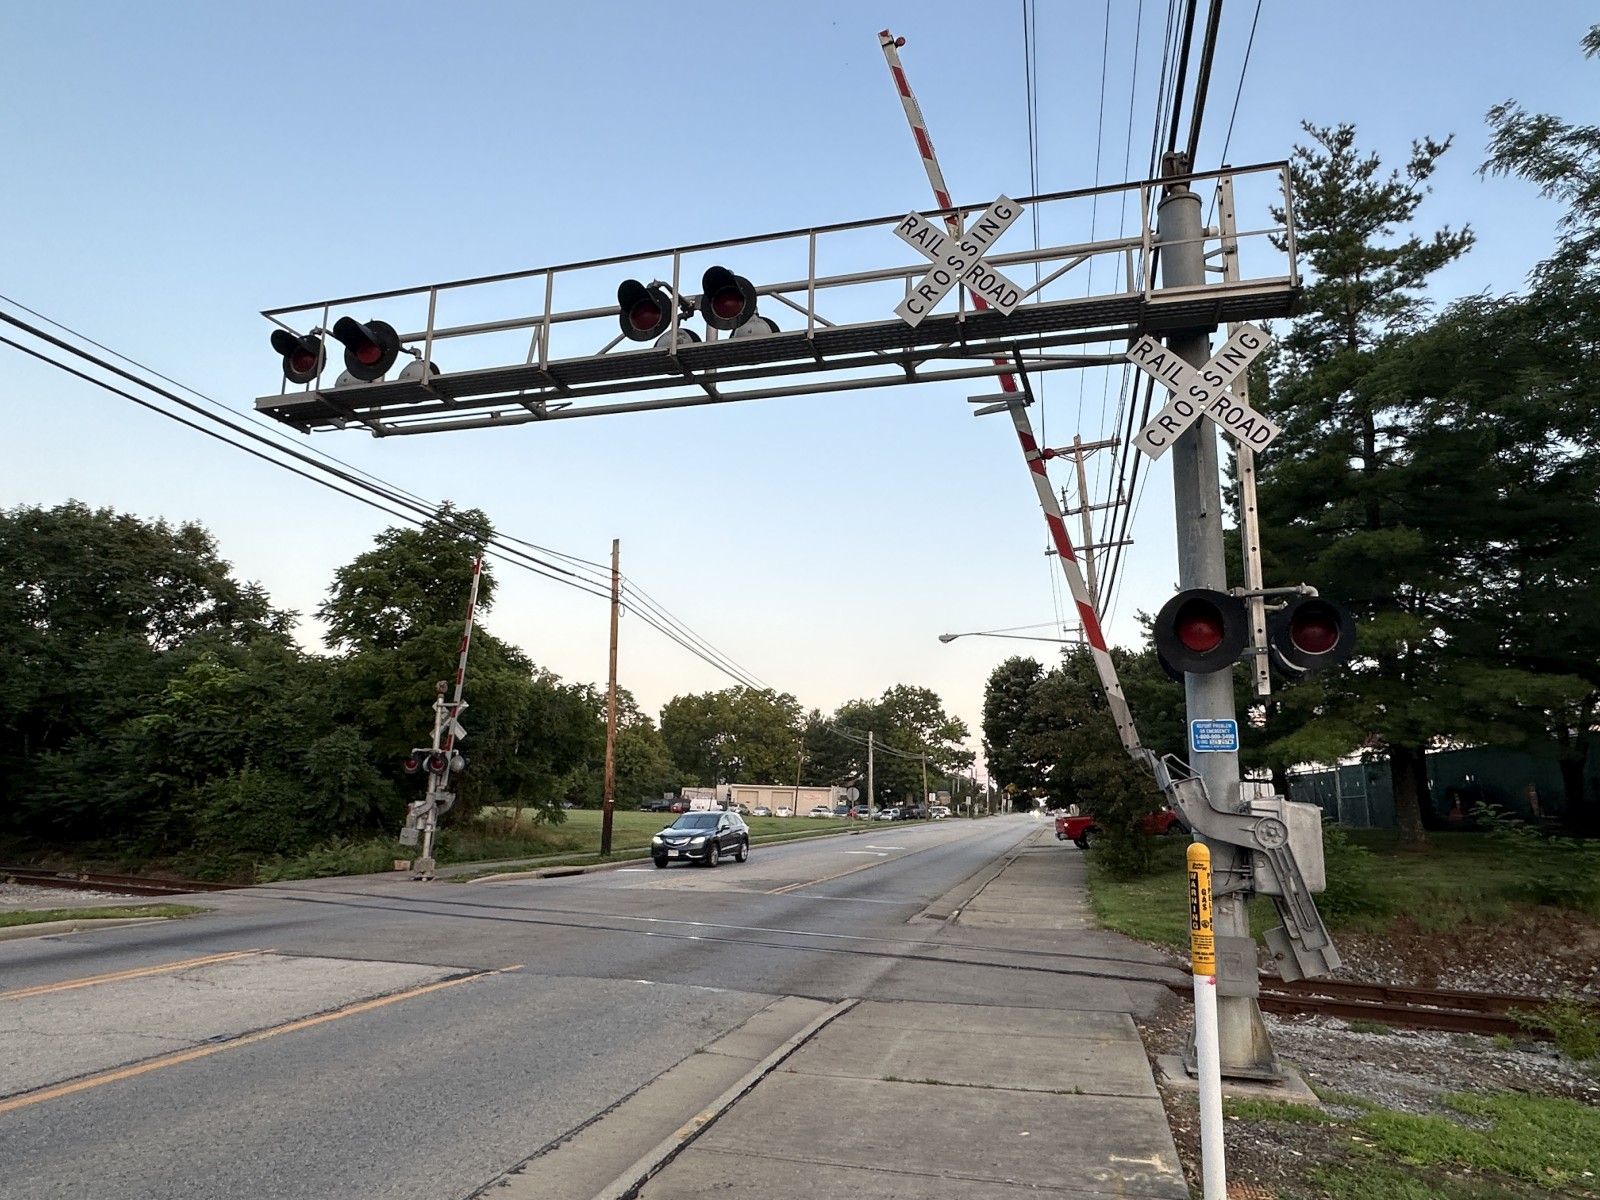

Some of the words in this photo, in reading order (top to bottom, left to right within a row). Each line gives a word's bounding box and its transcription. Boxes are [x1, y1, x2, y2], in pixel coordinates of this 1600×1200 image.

[900, 216, 944, 257] RAIL
[966, 265, 1018, 308] ROAD
[906, 205, 1012, 314] CROSSING
[1133, 341, 1184, 386] RAIL
[1210, 396, 1271, 444] ROAD
[1145, 333, 1260, 447] CROSSING
[1190, 872, 1199, 930] WARNING
